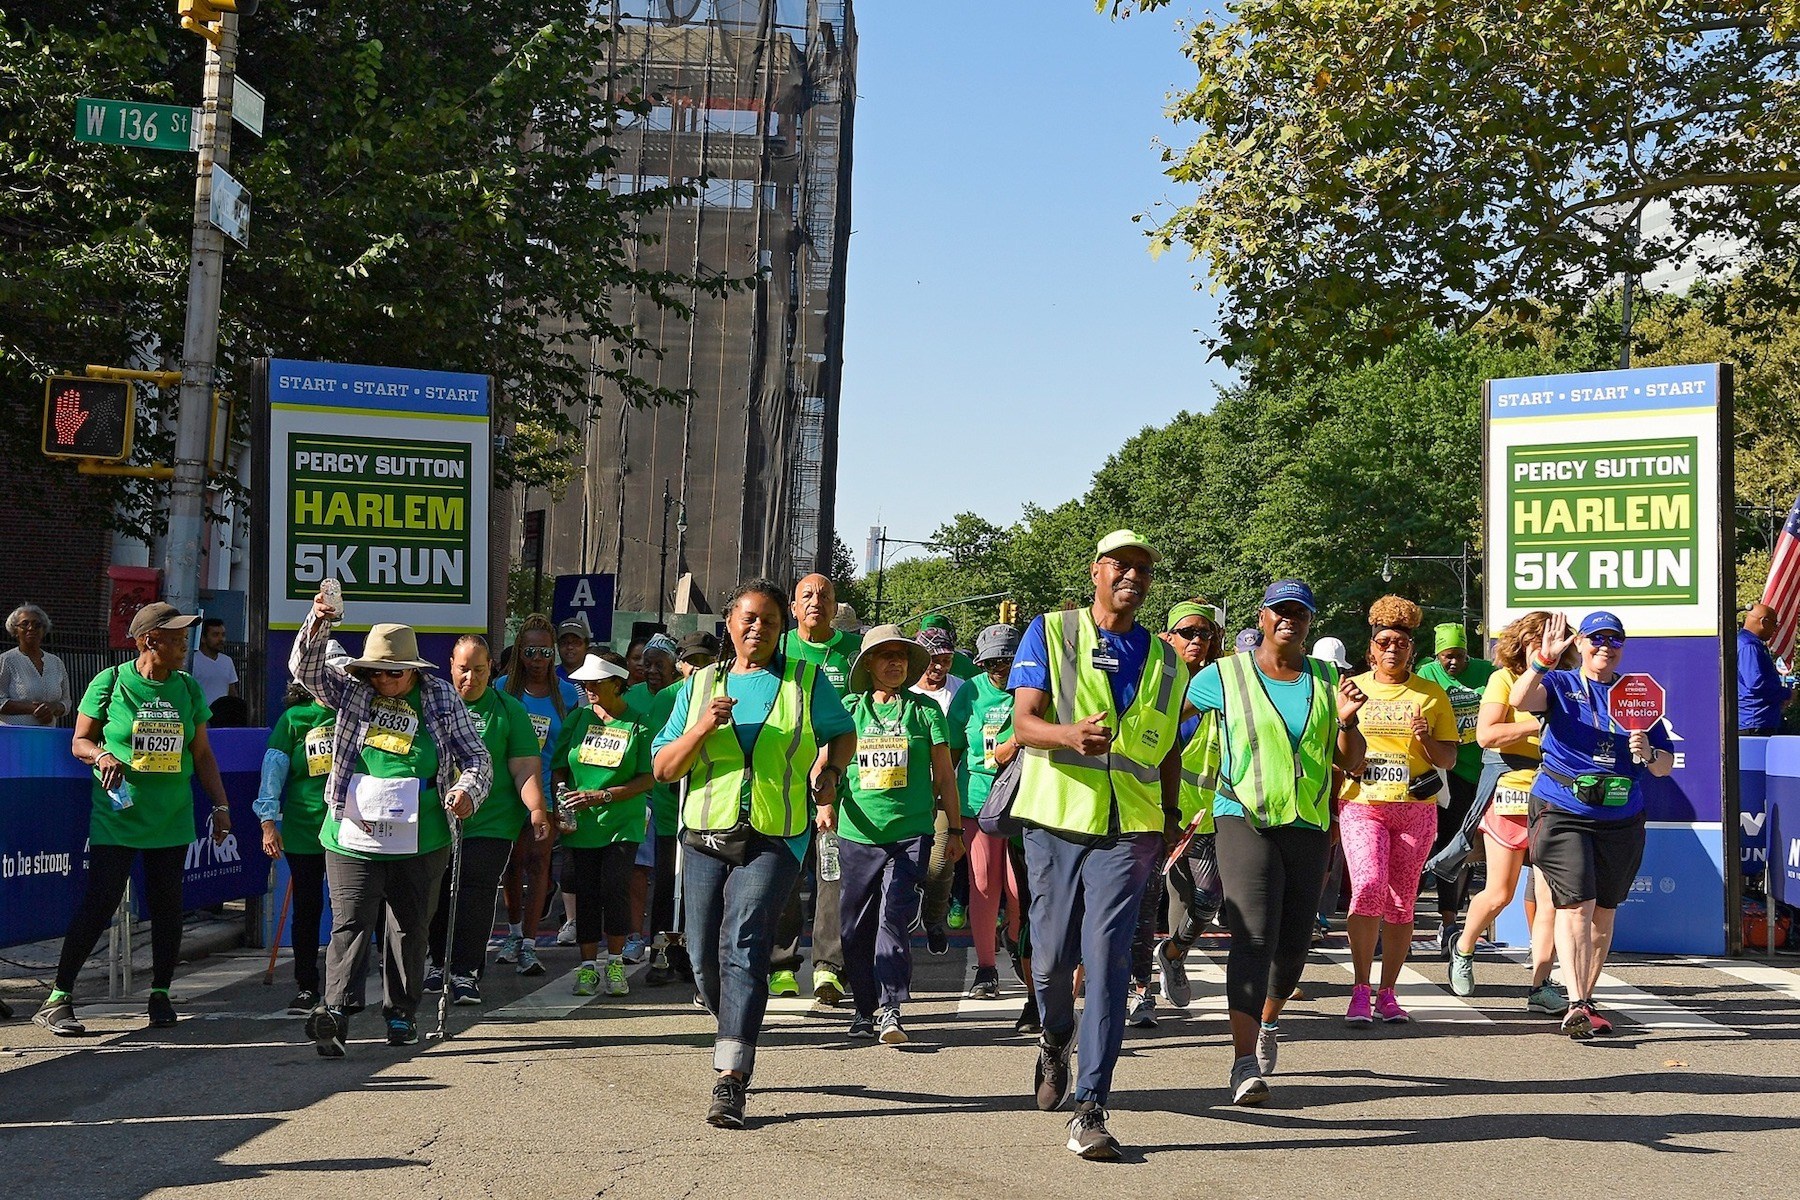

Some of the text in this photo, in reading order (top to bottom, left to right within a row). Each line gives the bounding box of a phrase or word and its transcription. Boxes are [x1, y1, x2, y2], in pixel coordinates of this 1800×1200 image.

[86, 105, 188, 142] W 136 St
[280, 376, 479, 402] START START START
[1498, 380, 1706, 407] START START START
[296, 451, 464, 478] PERCY SUTTON
[1514, 455, 1690, 482] PERCY SUTTON
[295, 490, 464, 530] HARLEM
[1514, 494, 1690, 534] HARLEM
[294, 543, 464, 586] 5K RUN
[1514, 548, 1690, 590] 5K RUN
[570, 579, 596, 606] A
[137, 711, 180, 719] STRIDERS
[1615, 708, 1658, 717] in Motion
[1618, 699, 1656, 708] Walkers
[379, 712, 410, 732] 6339
[135, 736, 177, 752] W 6297
[308, 741, 334, 756] W 63
[584, 735, 620, 750] W 6340
[986, 738, 994, 750] W
[860, 752, 900, 768] W 6341
[1374, 766, 1403, 782] 6269
[1496, 790, 1529, 804] W 6441
[3, 854, 14, 878] to
[17, 851, 31, 876] be
[34, 852, 72, 877] strong.
